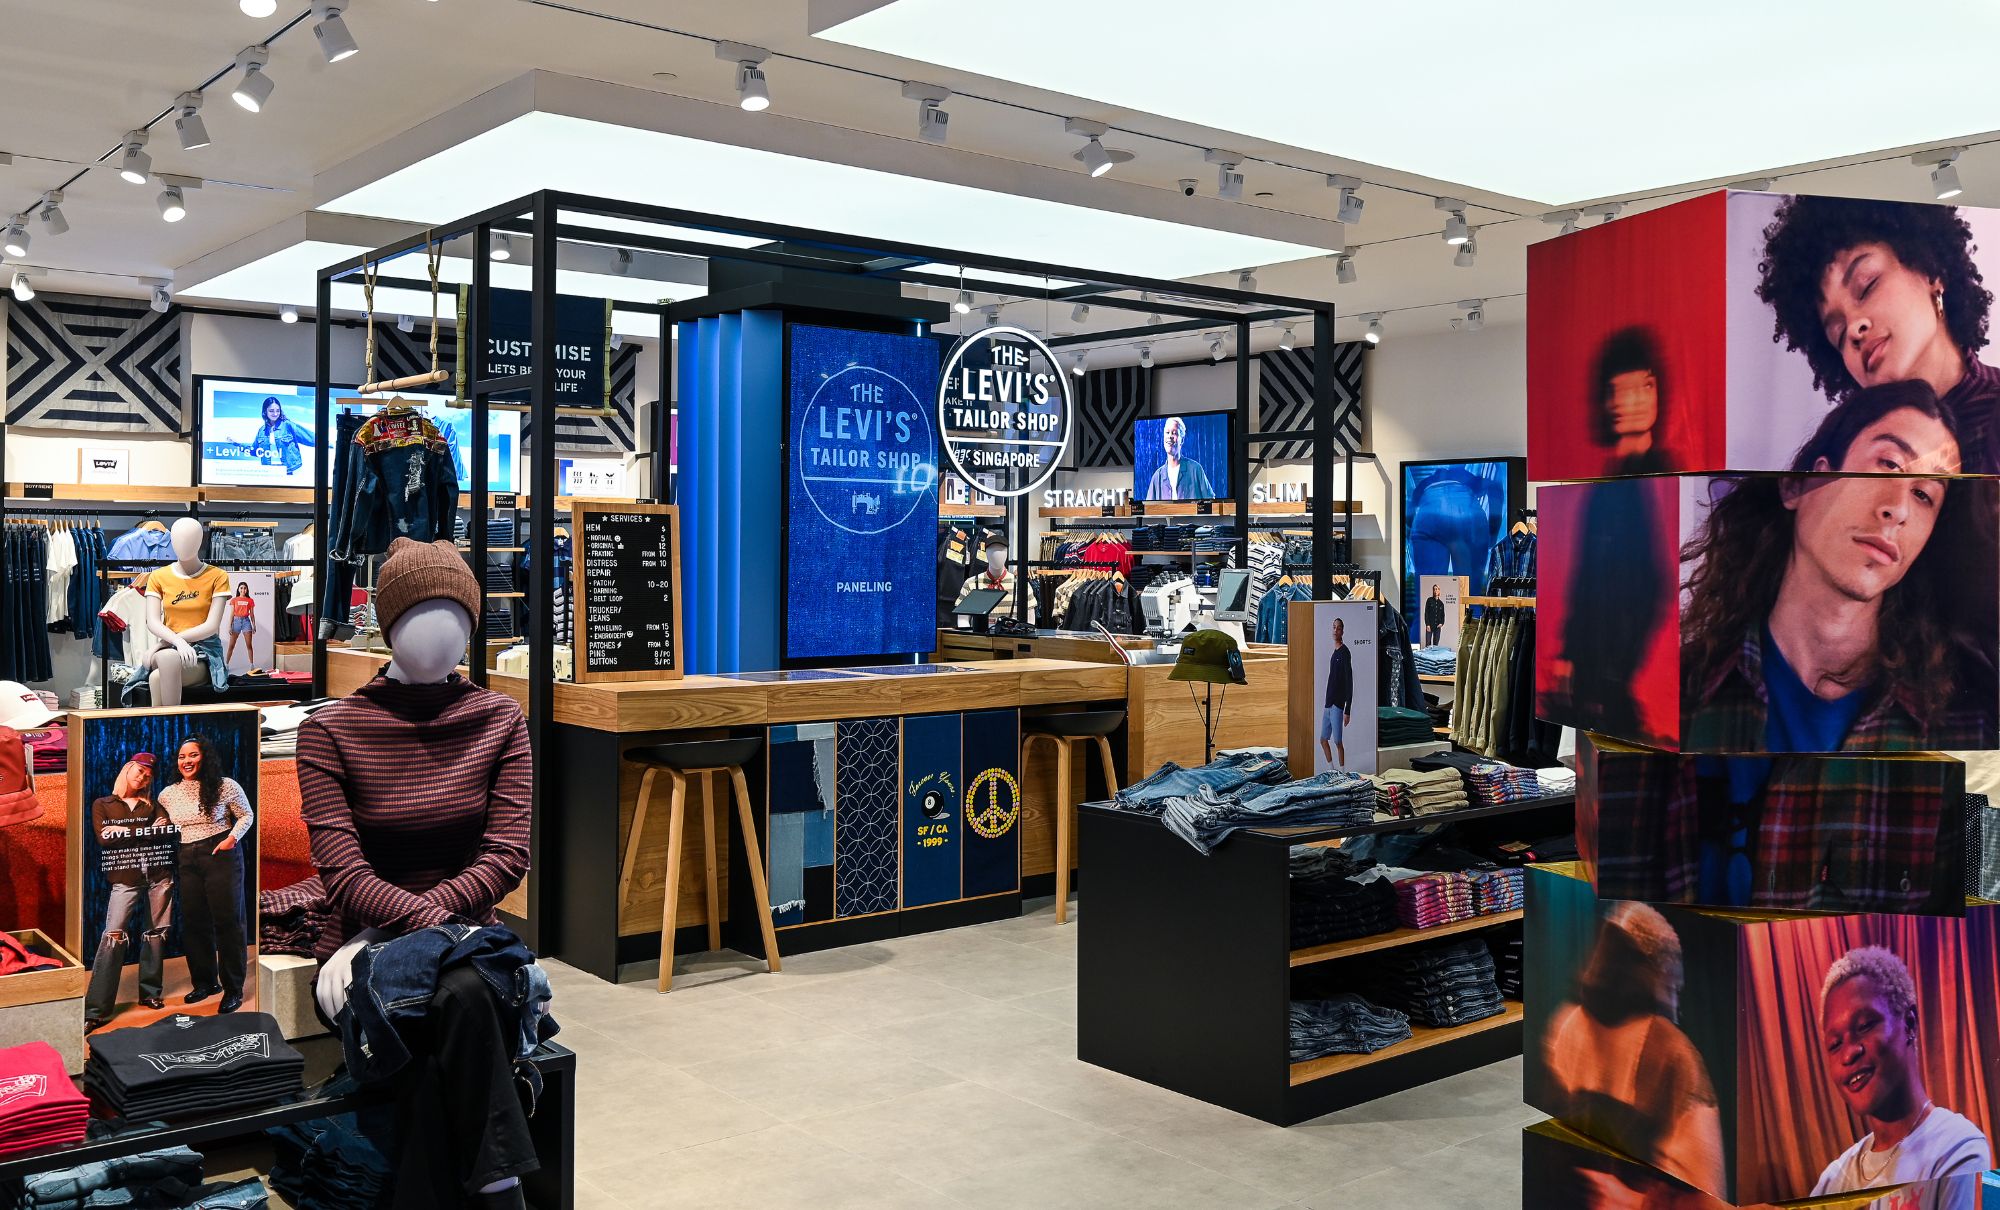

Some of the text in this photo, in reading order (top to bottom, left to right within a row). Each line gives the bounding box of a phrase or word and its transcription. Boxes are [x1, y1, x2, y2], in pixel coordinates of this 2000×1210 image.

[991, 345, 1025, 366] THE
[488, 363, 517, 375] LETS
[556, 368, 586, 380] YOUR
[554, 382, 578, 393] LIFE
[850, 383, 884, 404] THE
[953, 408, 1059, 432] TAILOR SHOP
[256, 447, 283, 459] Cool
[811, 447, 921, 470] TAILOR SHOP
[973, 450, 1040, 468] SINGAPORE
[1043, 488, 1126, 508] STRAIGHT
[1252, 482, 1303, 504] SLIM
[610, 515, 642, 523] SERVICES
[586, 524, 601, 532] HEM
[587, 569, 611, 577] REPAIR
[836, 581, 892, 593] PANELING
[102, 824, 182, 839] GIVE BETTER
[918, 826, 928, 836] SF
[936, 825, 948, 834] CA
[923, 837, 942, 847] 1999
